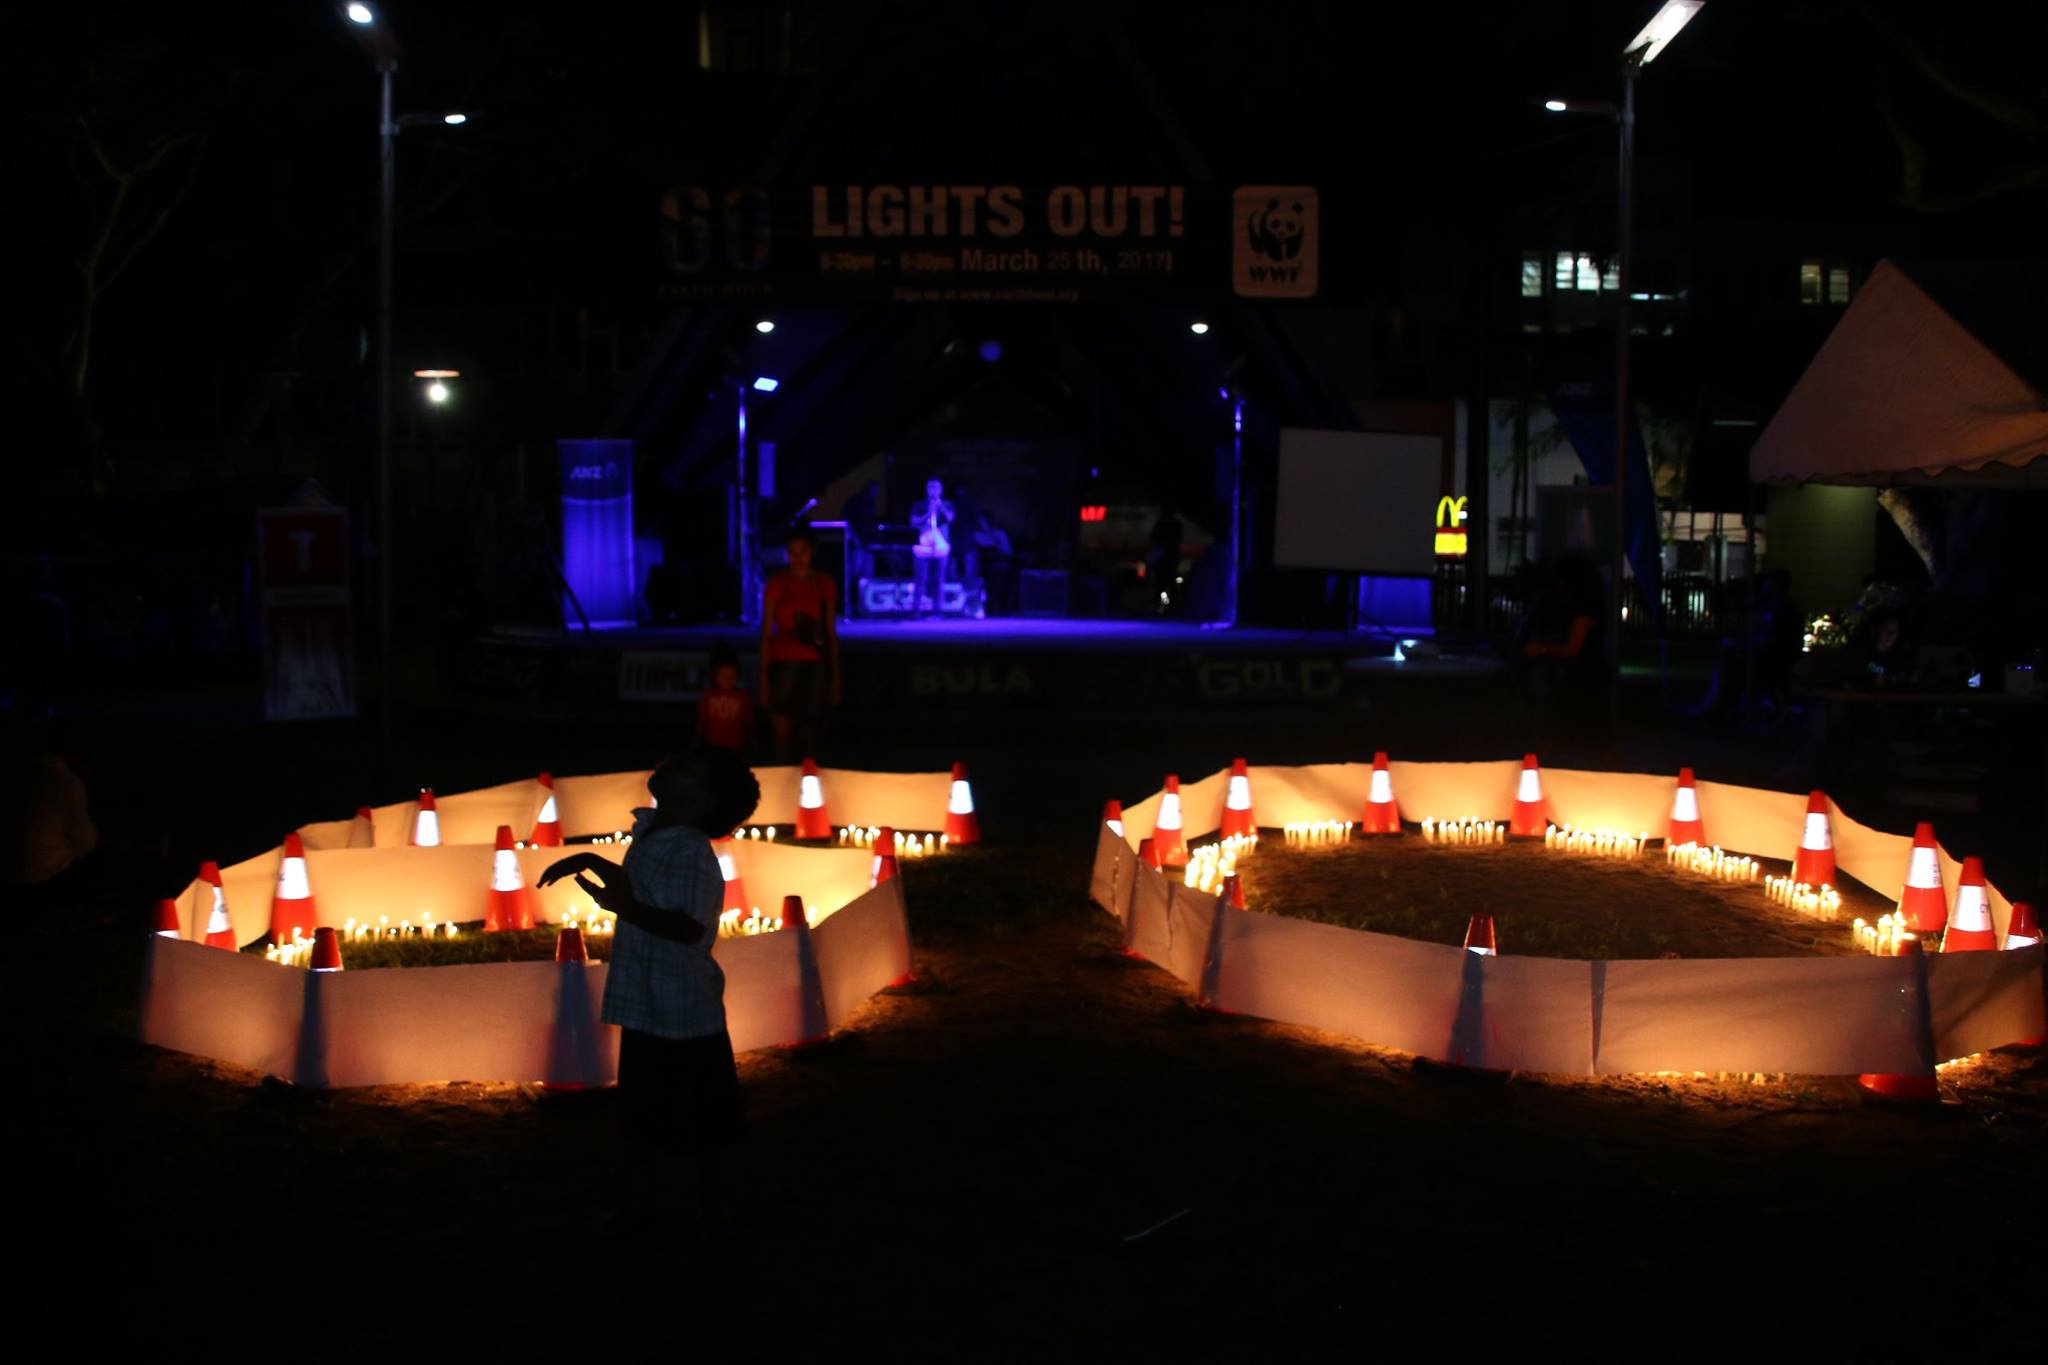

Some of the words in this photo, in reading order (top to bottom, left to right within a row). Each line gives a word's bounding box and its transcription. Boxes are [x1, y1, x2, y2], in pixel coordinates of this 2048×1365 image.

[811, 184, 1025, 238] LIGHTS
[1046, 184, 1185, 238] OUT!
[961, 248, 1039, 272] March
[1249, 266, 1301, 283] WWF
[911, 664, 1033, 696] BULA
[1198, 658, 1344, 698] GOLD
